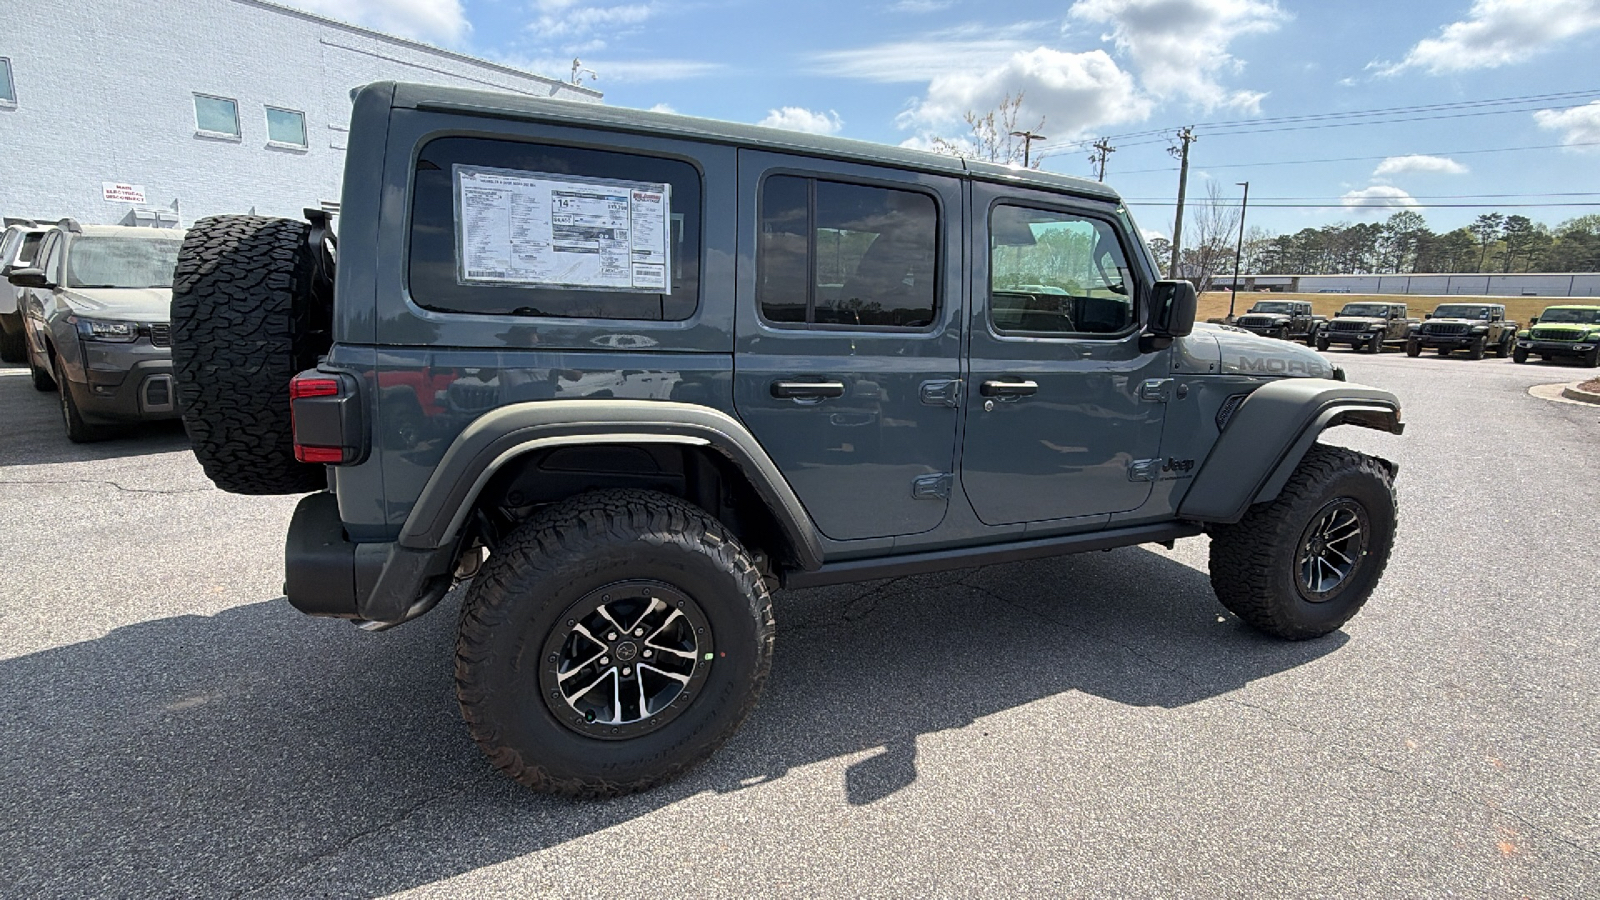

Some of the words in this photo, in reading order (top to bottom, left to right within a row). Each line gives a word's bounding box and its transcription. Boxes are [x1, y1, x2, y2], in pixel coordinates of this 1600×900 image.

[557, 199, 569, 208] 14
[1239, 356, 1323, 375] MOAB
[1162, 457, 1195, 473] Jeep
